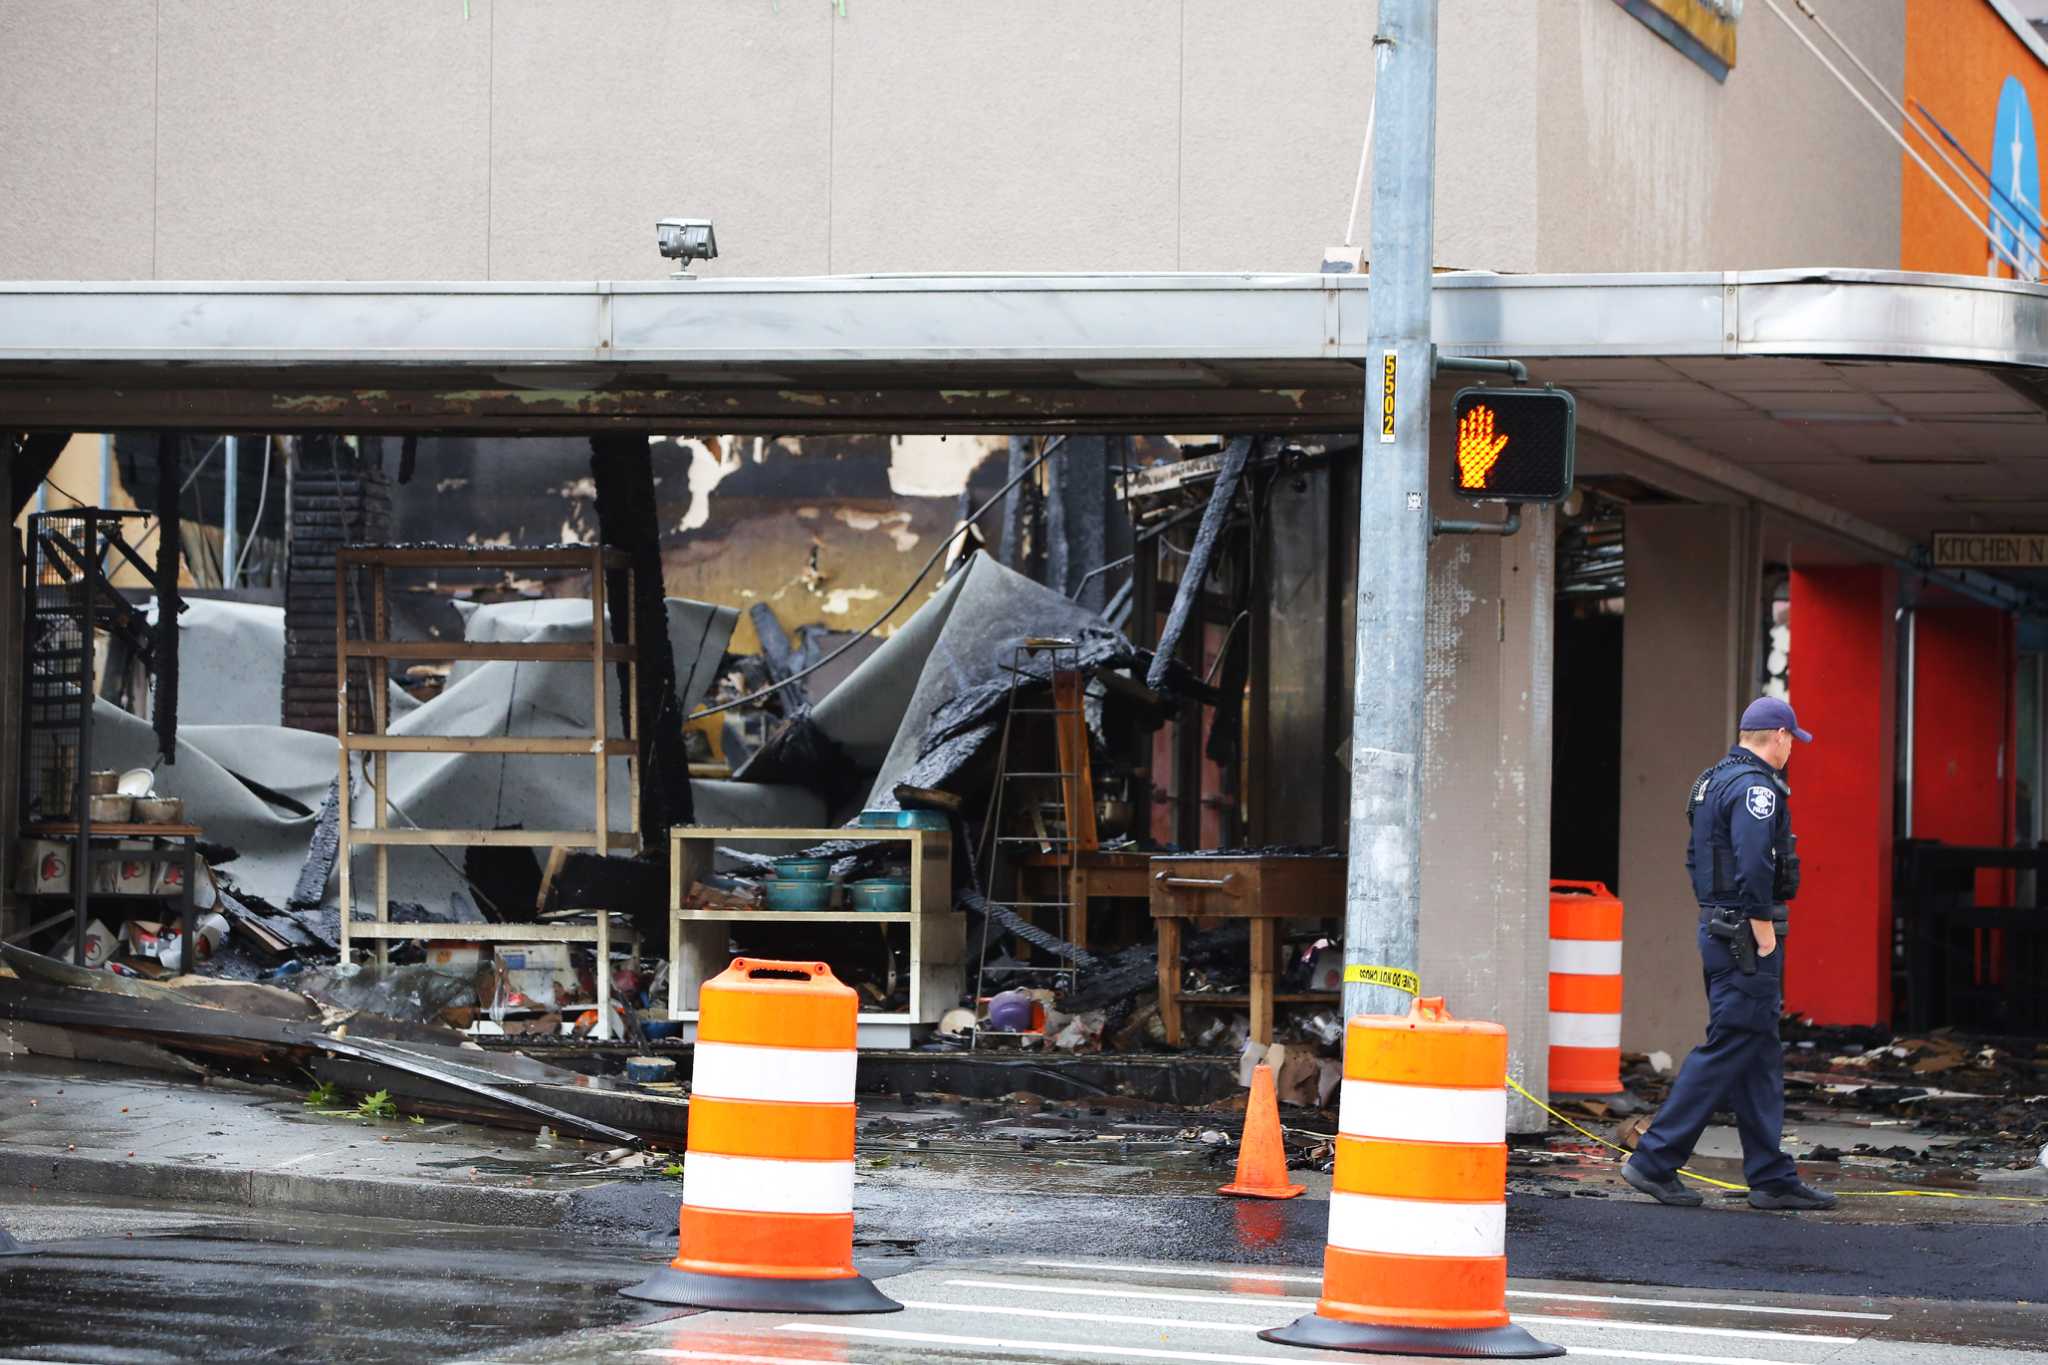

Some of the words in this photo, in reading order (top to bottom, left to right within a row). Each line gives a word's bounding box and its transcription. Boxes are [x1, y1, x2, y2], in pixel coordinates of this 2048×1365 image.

[1384, 355, 1395, 434] 5502
[1938, 537, 2019, 563] KITCHEN
[1379, 970, 1392, 985] NOT
